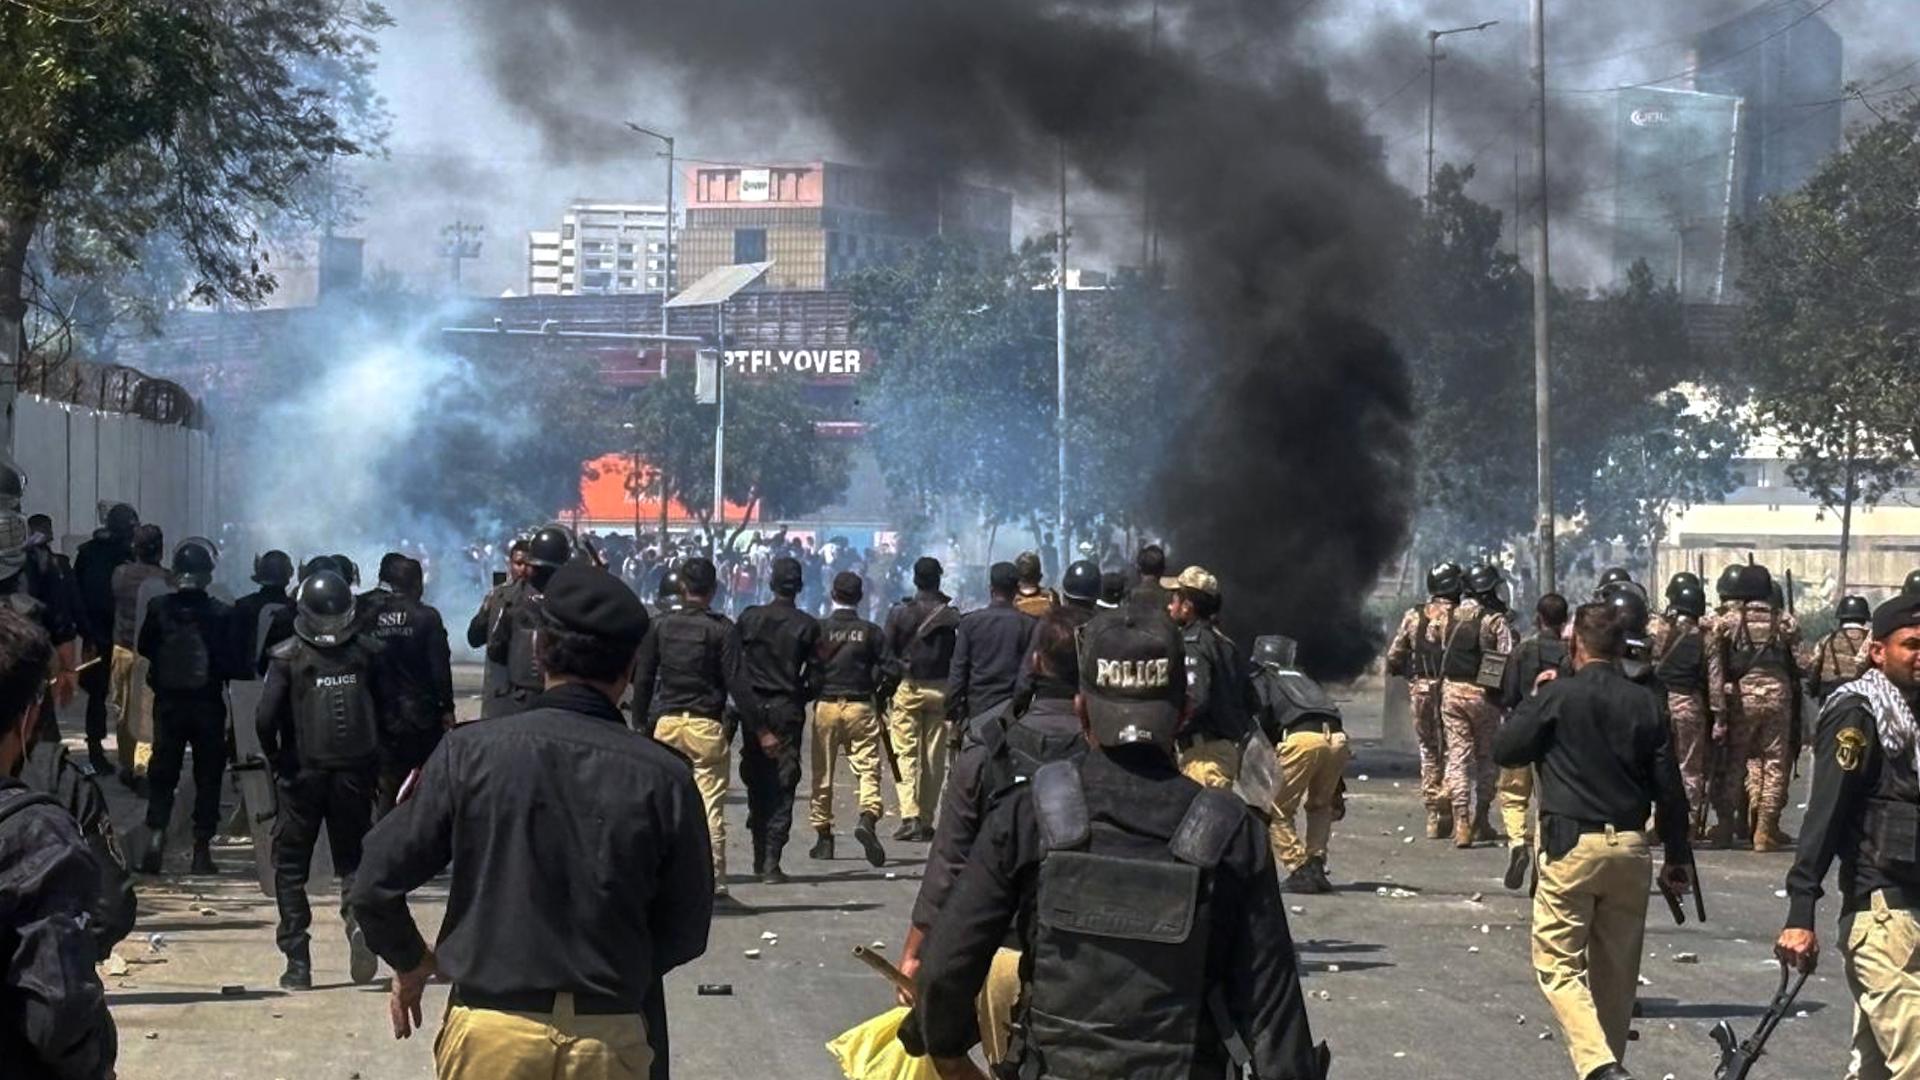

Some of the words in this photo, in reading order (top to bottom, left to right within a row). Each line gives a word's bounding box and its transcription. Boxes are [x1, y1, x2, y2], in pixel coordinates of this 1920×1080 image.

[378, 611, 407, 626] SSU
[1096, 658, 1169, 687] POLICE
[316, 674, 356, 687] POLICE
